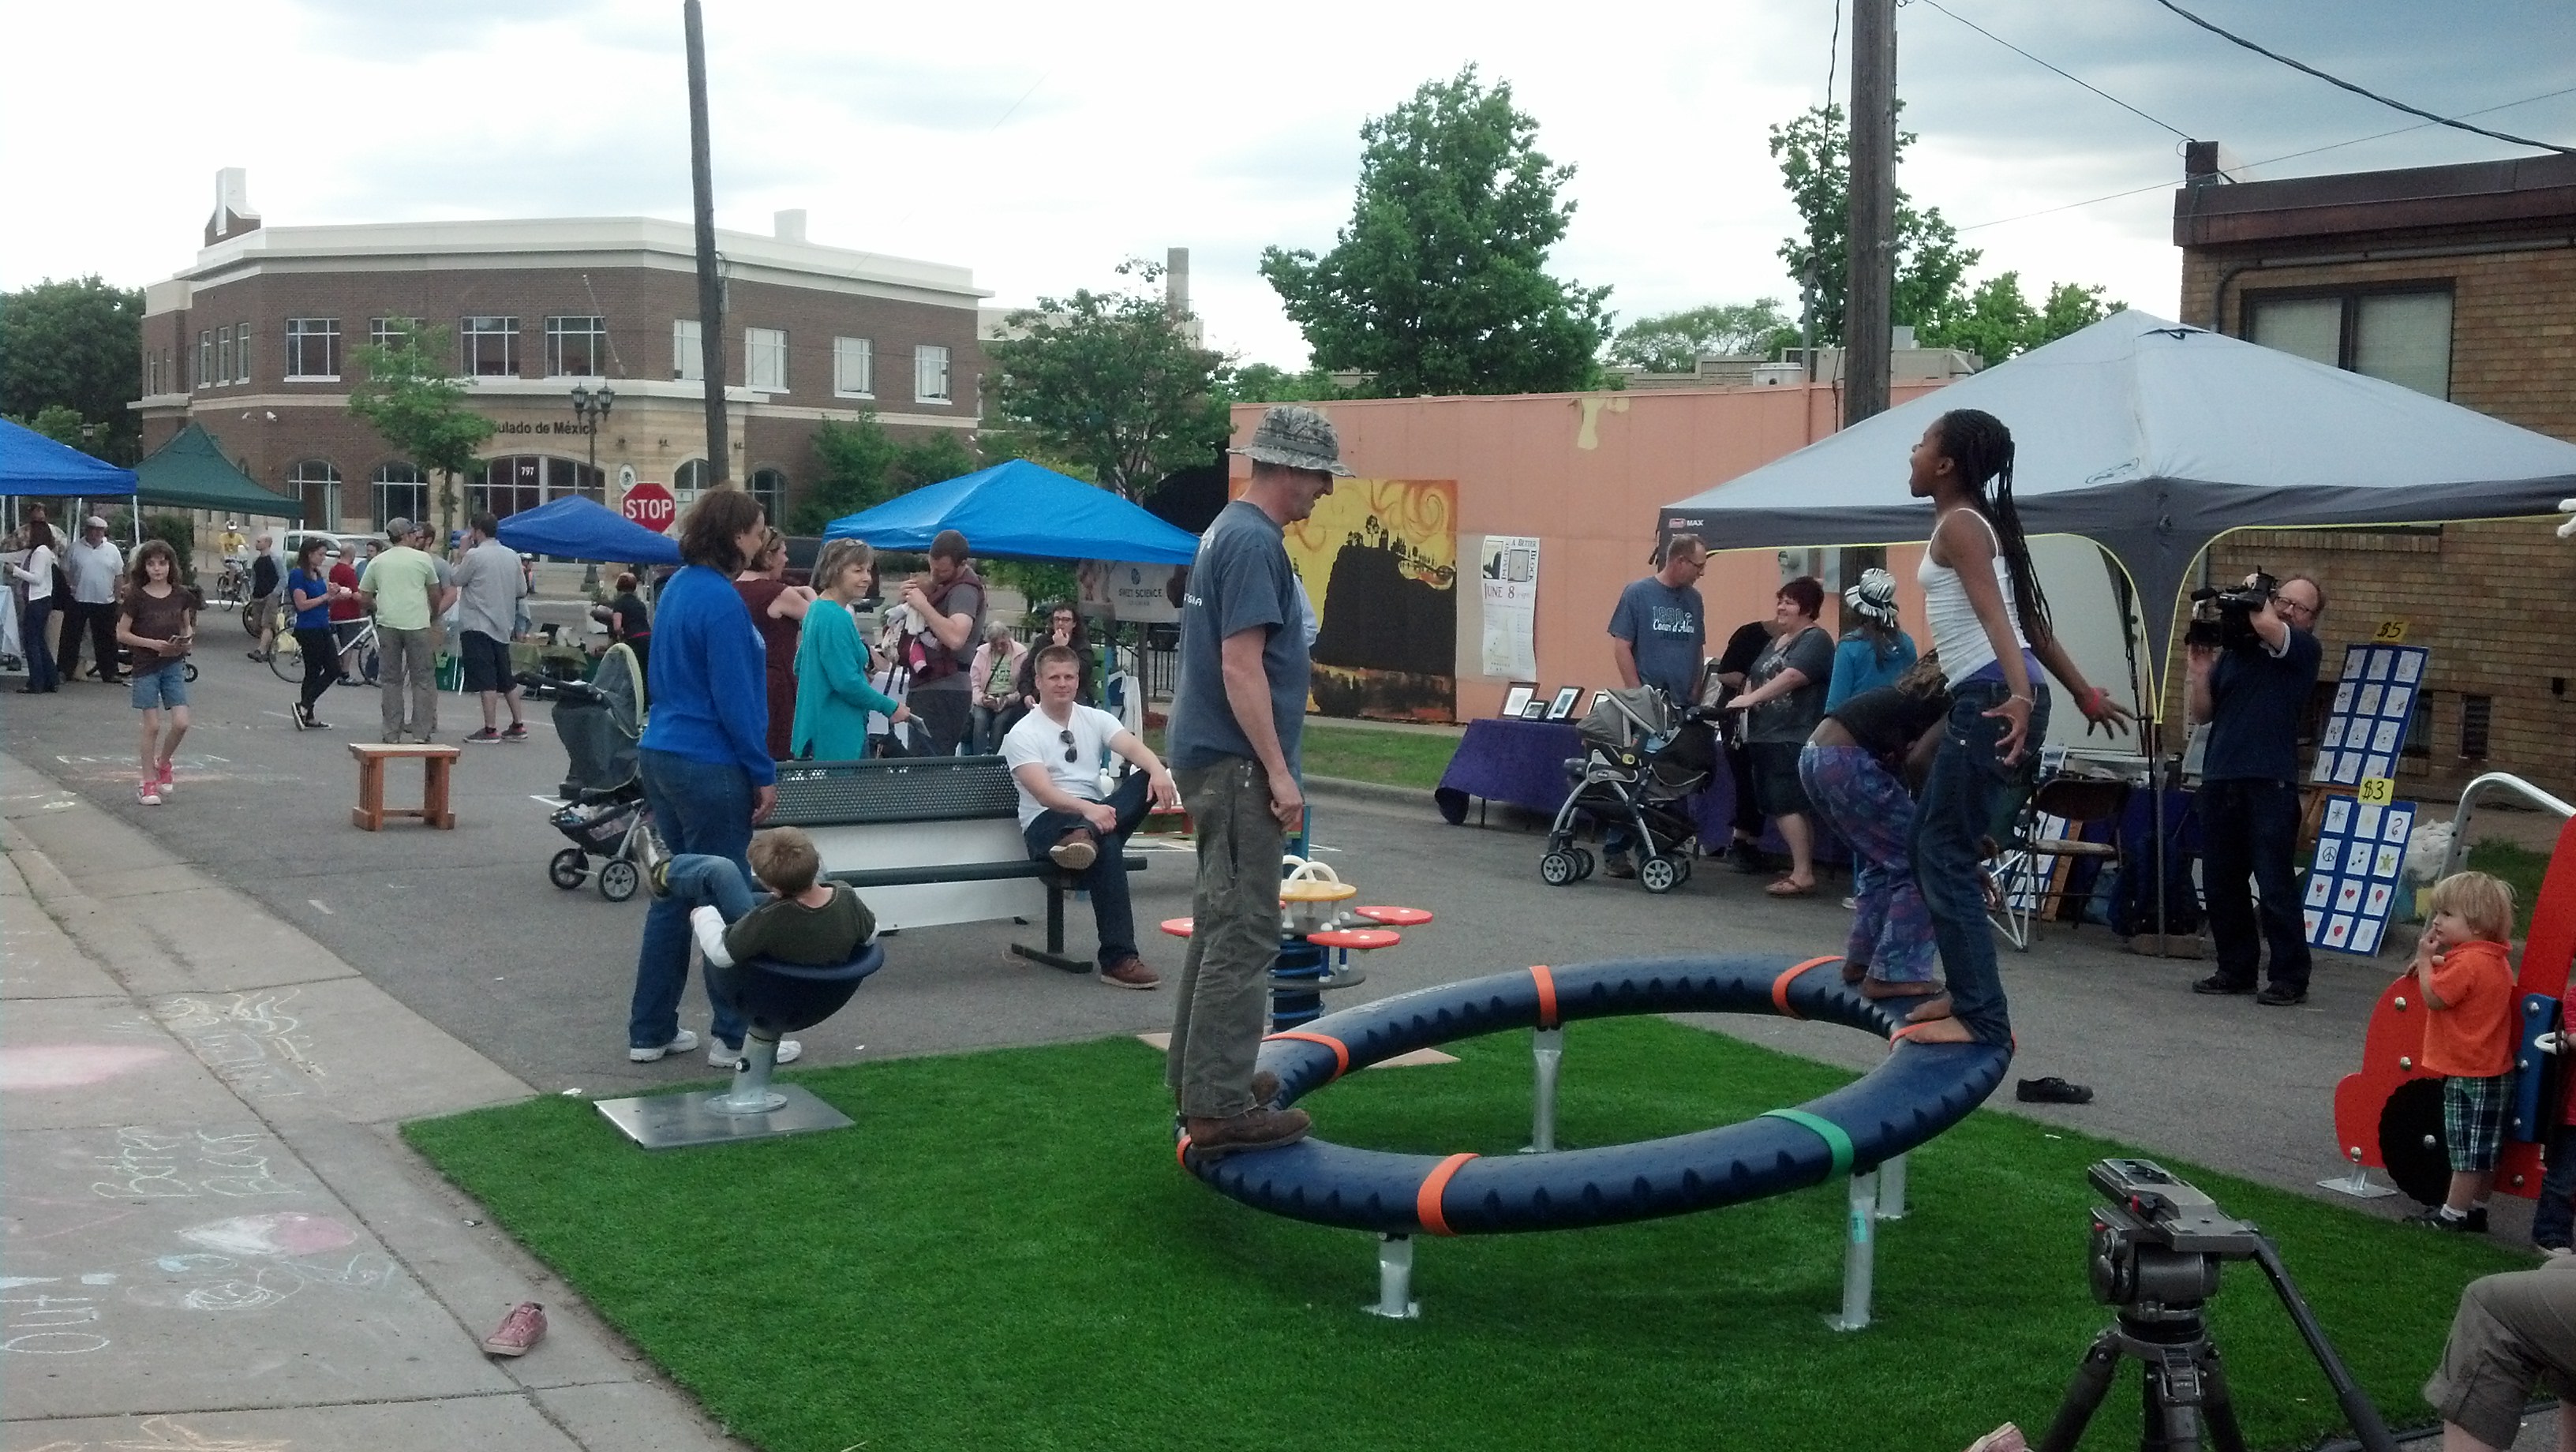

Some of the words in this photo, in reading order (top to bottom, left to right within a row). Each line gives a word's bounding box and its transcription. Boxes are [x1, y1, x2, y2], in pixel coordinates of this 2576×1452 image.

[535, 421, 550, 434] de
[521, 466, 534, 476] 797
[625, 499, 672, 519] STOP
[1135, 589, 1163, 598] SCIENCE
[1484, 583, 1503, 600] JUNE
[1507, 586, 1515, 599] 8
[2376, 621, 2404, 638] $5
[2362, 780, 2384, 799] $3
